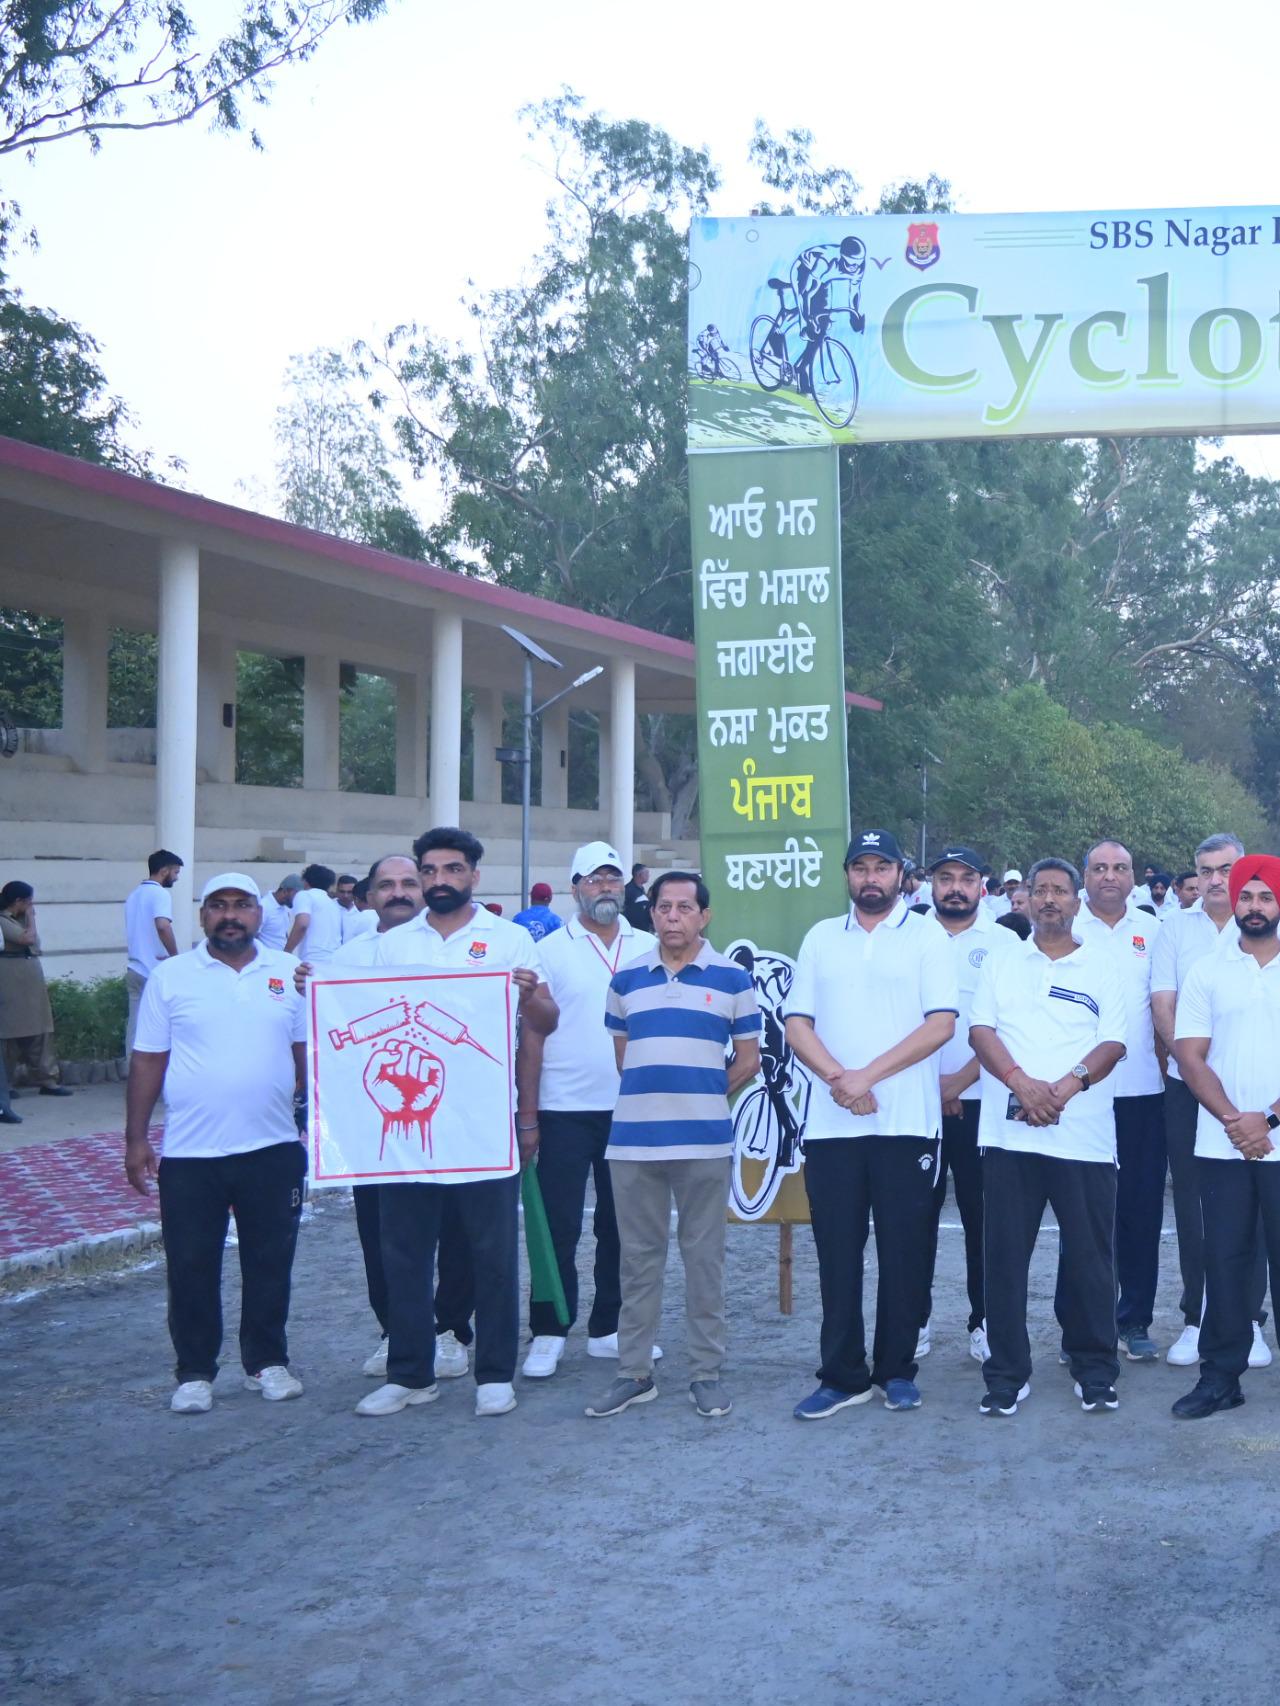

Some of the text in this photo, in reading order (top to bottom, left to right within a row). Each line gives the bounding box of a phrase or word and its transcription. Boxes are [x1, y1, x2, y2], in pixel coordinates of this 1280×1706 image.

[1090, 220, 1154, 249] SBS
[1164, 219, 1262, 256] Nagar
[709, 486, 818, 540] ਆਓ ਮਨ
[699, 558, 830, 610] ਵਿੱਚ ਮਸ਼ਾਲ
[717, 622, 816, 677] ਜਗਾਈਏ
[708, 704, 830, 754] ਨਸ਼ਾ ਮੁਕਤ
[730, 757, 814, 821] ਪੰਜਾਬ
[725, 836, 823, 891] ਬਣਾਈਏ
